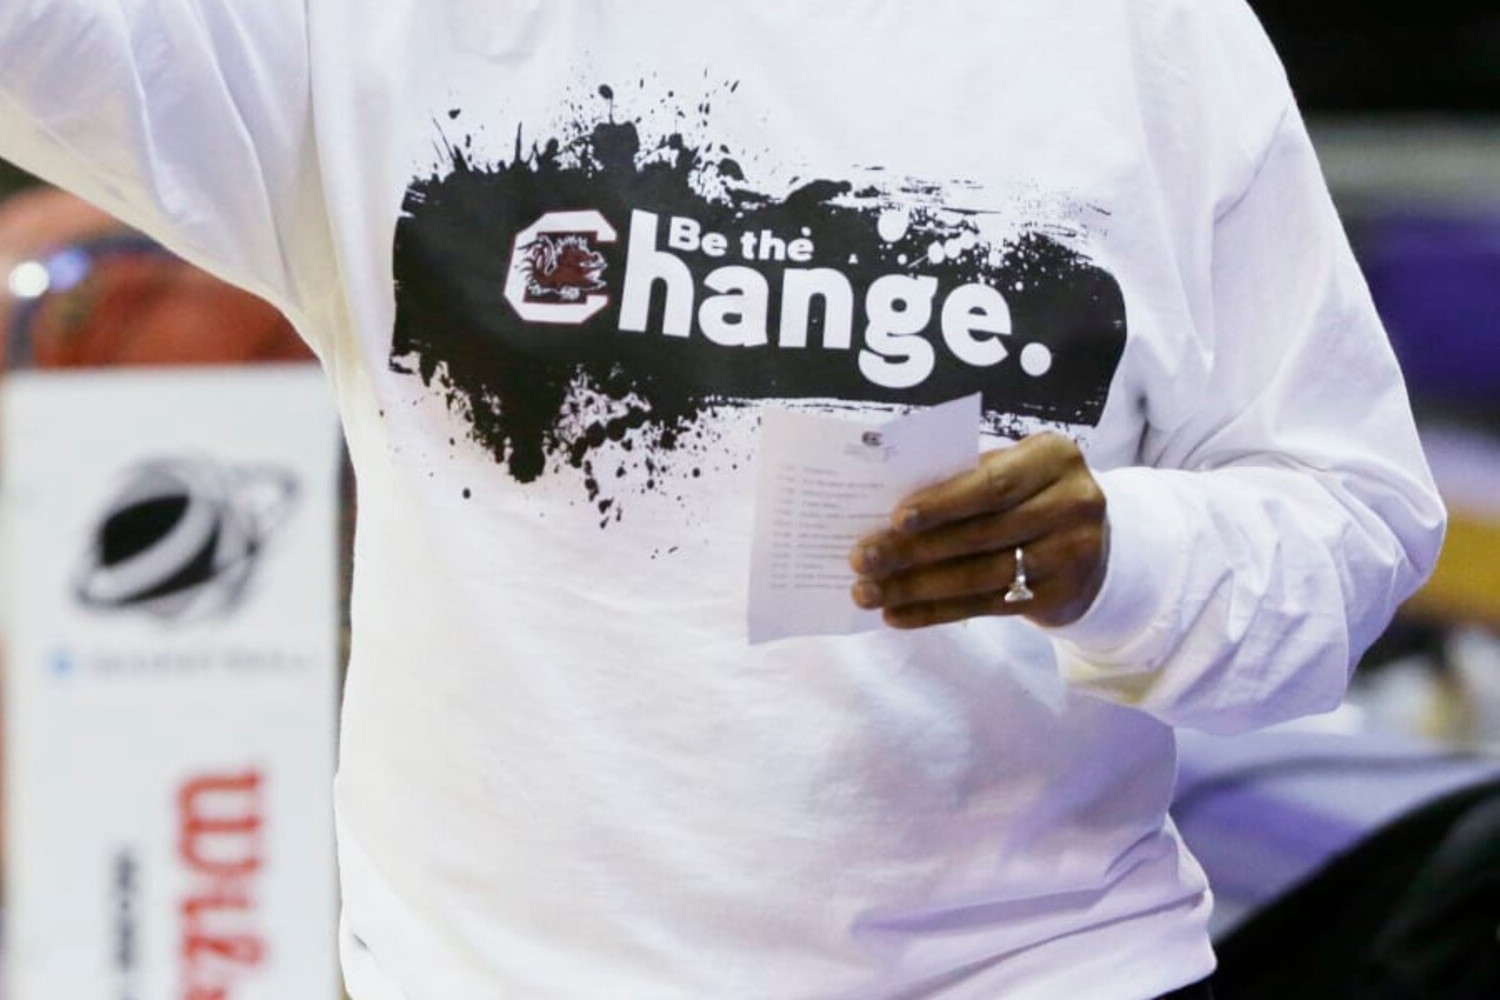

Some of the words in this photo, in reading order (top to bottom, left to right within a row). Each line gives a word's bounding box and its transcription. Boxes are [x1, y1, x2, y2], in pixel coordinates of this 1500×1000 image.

[667, 216, 728, 258] Be
[740, 228, 815, 263] the
[503, 208, 1054, 389] Change.
